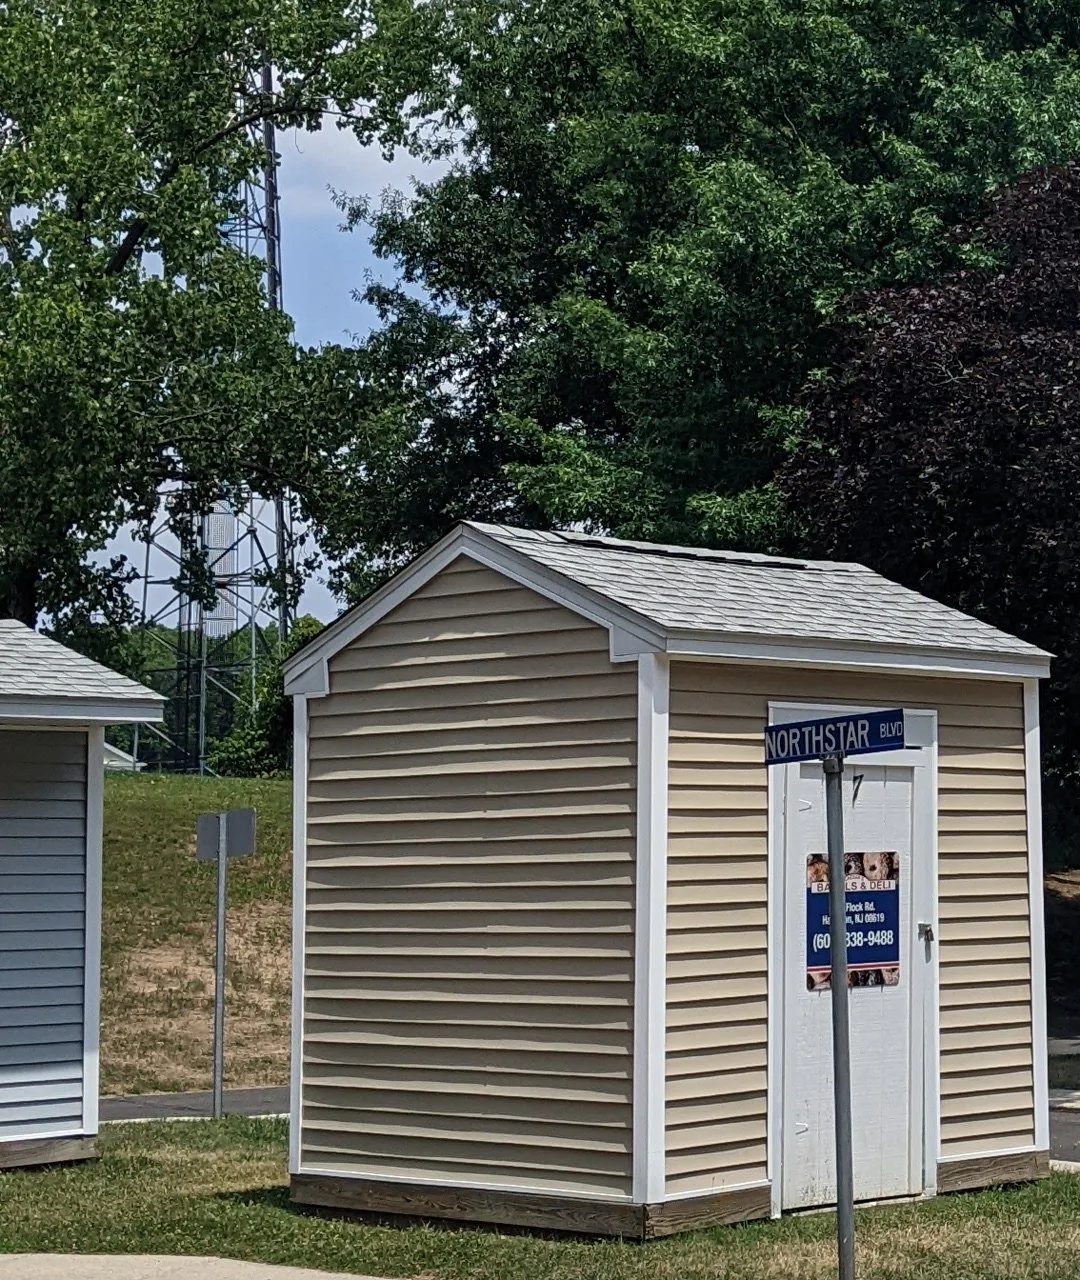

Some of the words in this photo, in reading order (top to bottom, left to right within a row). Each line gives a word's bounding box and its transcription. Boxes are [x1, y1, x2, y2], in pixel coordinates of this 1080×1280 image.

[765, 719, 870, 760] NORTHSTAR
[880, 721, 903, 738] BLVD
[852, 774, 865, 809] 7
[817, 882, 857, 892] BALS
[860, 881, 867, 890] &
[869, 880, 892, 890] DELI
[845, 902, 863, 912] Flock
[864, 901, 876, 911] Rd.
[854, 913, 864, 924] NJ
